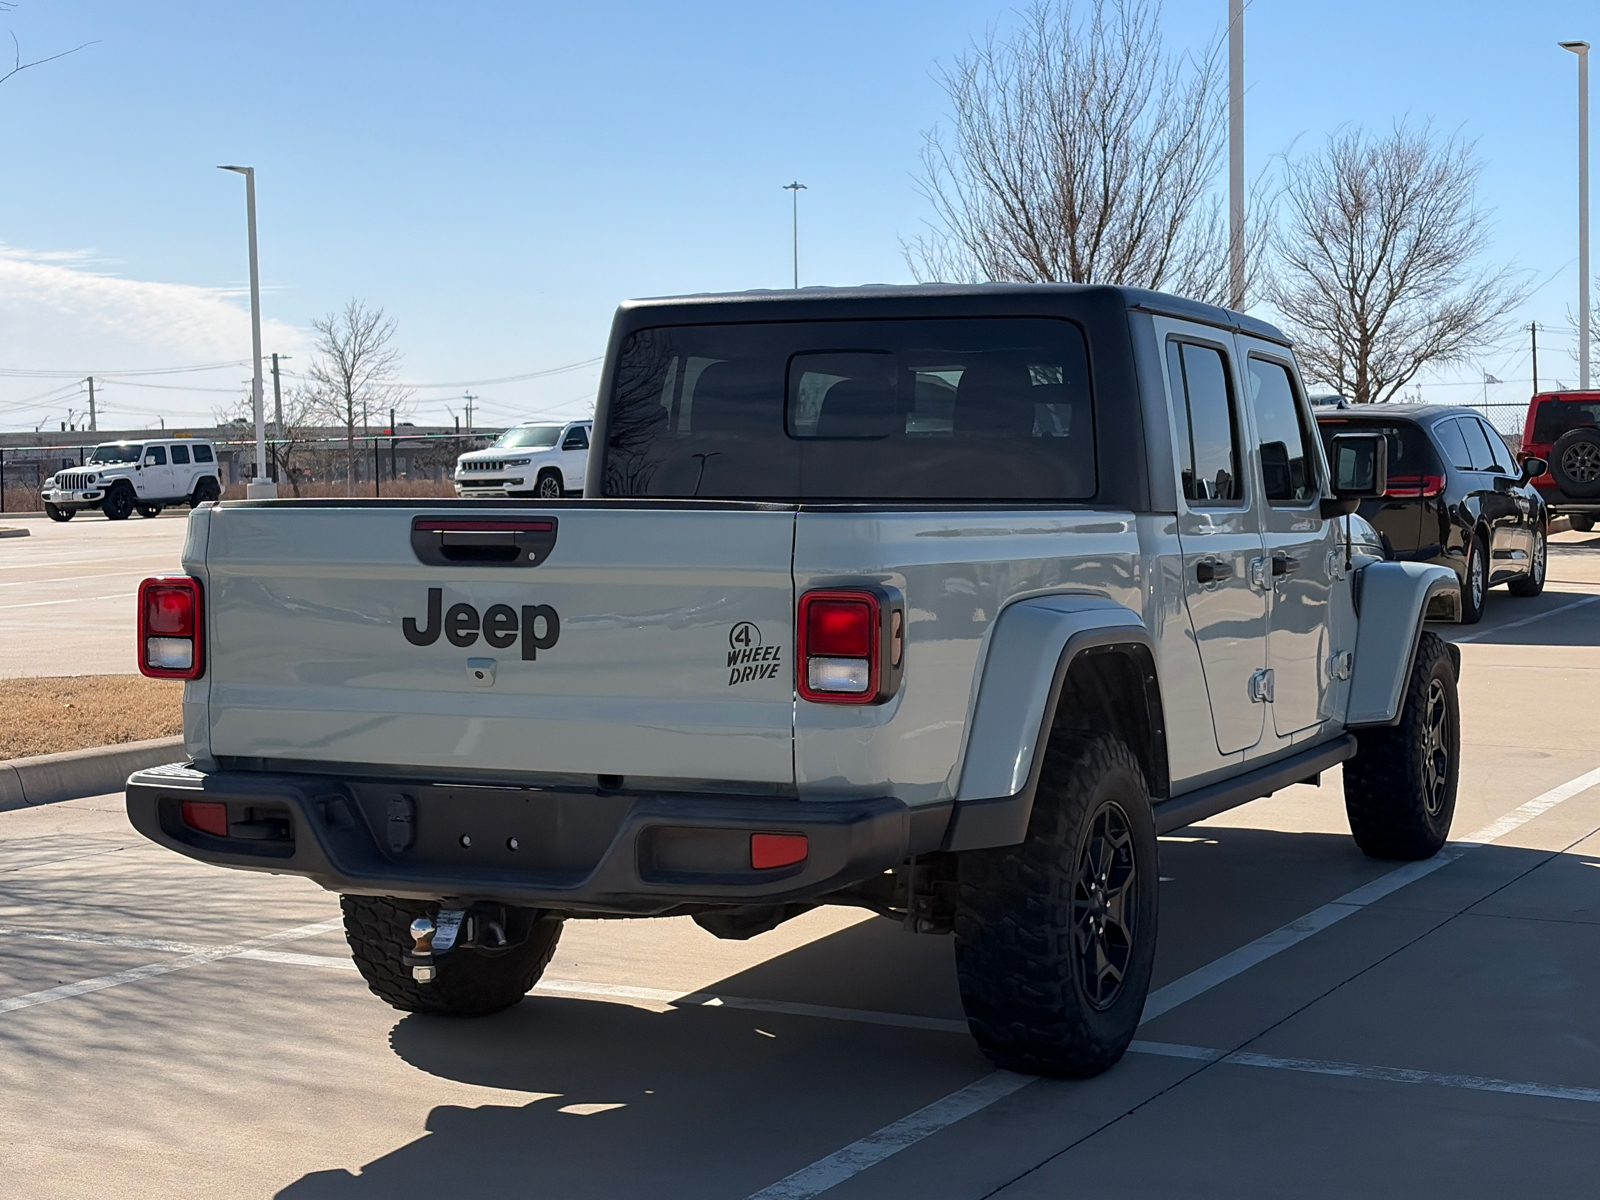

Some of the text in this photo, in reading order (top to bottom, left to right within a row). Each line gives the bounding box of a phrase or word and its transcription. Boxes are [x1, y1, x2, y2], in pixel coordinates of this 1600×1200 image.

[402, 587, 560, 661] Jeep
[734, 625, 752, 648] 4
[727, 645, 782, 668] WHEEL
[728, 663, 781, 687] DRIVE
